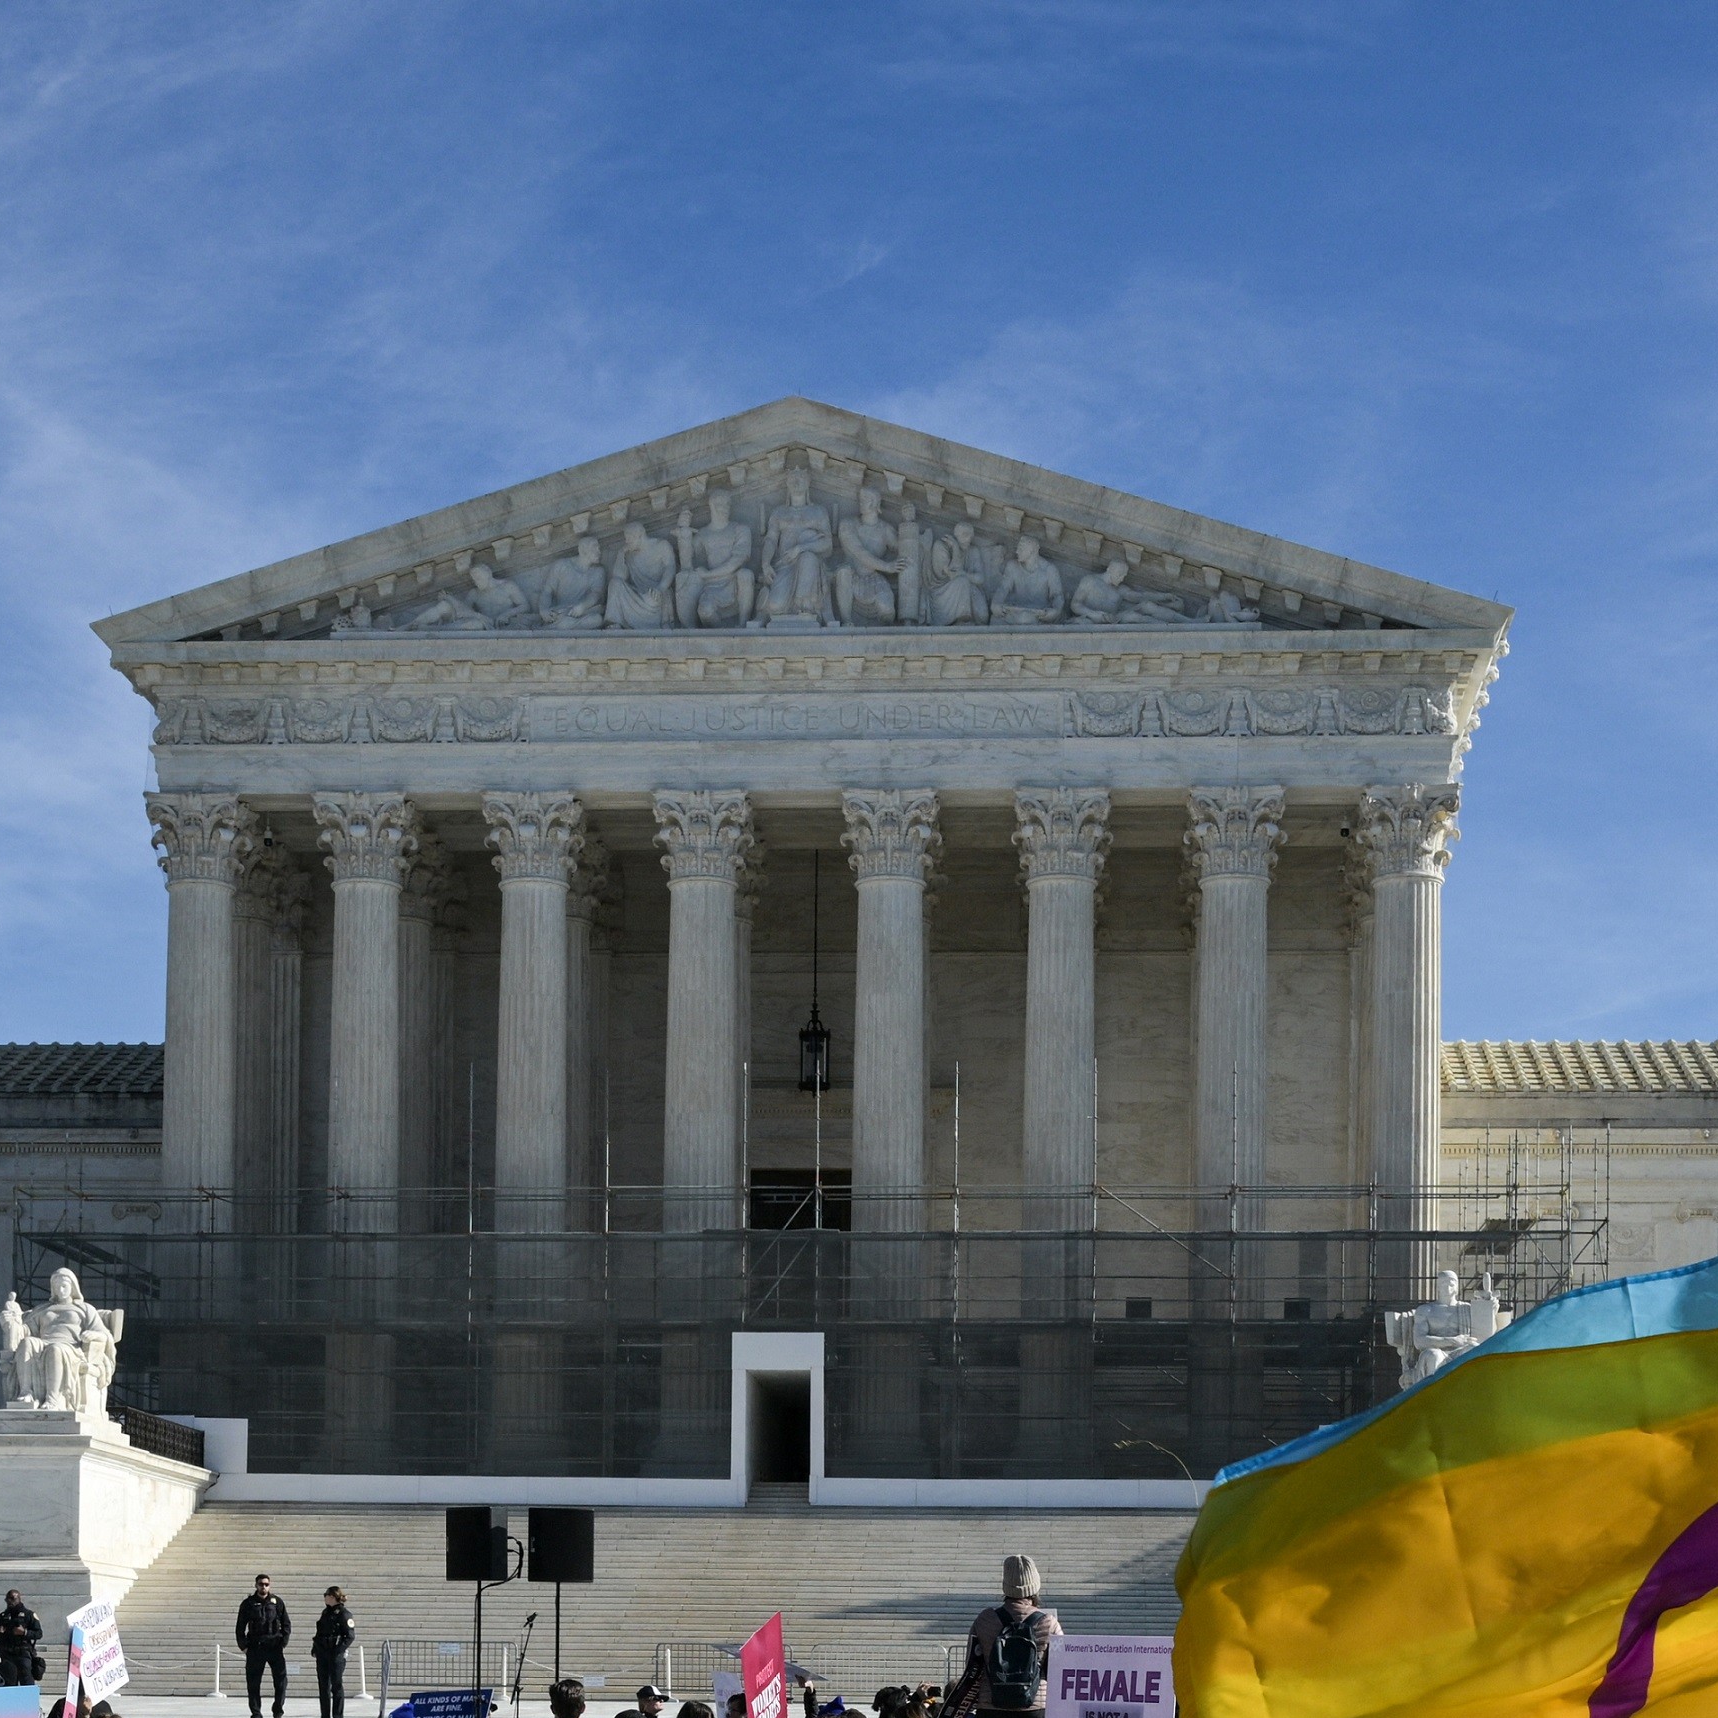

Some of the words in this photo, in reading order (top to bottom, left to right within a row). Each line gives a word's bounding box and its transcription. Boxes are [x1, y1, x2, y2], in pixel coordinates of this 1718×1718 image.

[555, 706, 673, 733] EQUAL
[683, 704, 820, 732] JUSTICE
[839, 703, 953, 731] UNDER
[971, 703, 1040, 730] LAW
[1064, 1643, 1094, 1653] Women's
[1094, 1644, 1133, 1654] Declaration
[755, 1658, 775, 1690] PROTECT
[1060, 1668, 1161, 1704] FEMALE
[414, 1697, 426, 1705] ALL
[427, 1696, 449, 1704] KINDS
[445, 1704, 463, 1712] FINE.
[751, 1672, 782, 1718] WOMEN'S
